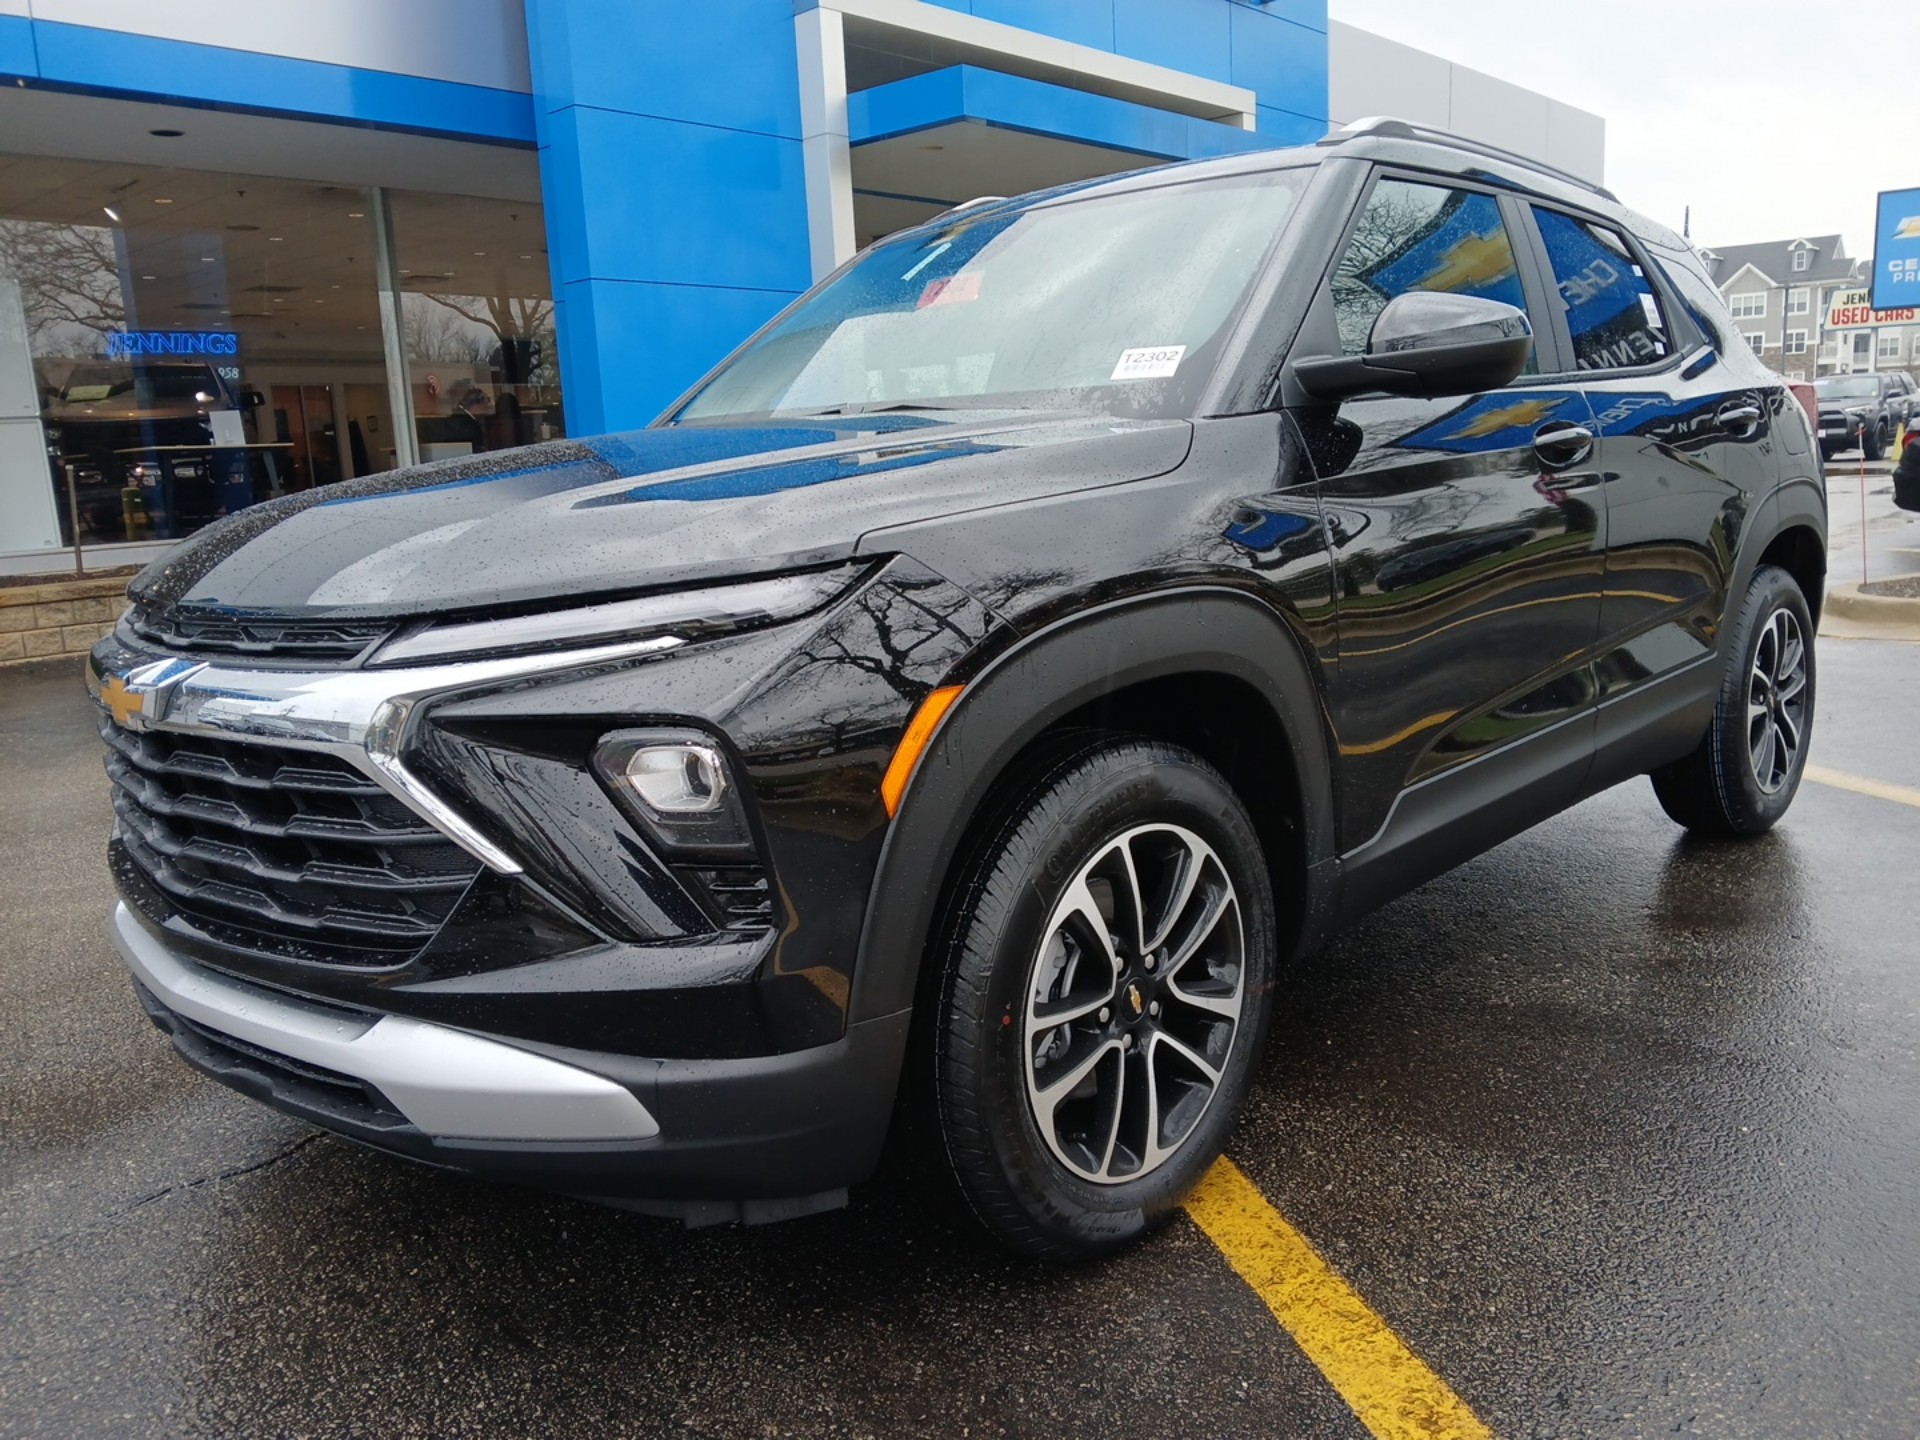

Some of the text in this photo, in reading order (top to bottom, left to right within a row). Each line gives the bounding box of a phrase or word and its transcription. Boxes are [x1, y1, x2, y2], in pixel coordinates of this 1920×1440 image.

[1832, 307, 1914, 325] USED CARS
[107, 333, 237, 354] JENNINGS
[1125, 350, 1179, 364] T2302
[218, 367, 239, 379] 958
